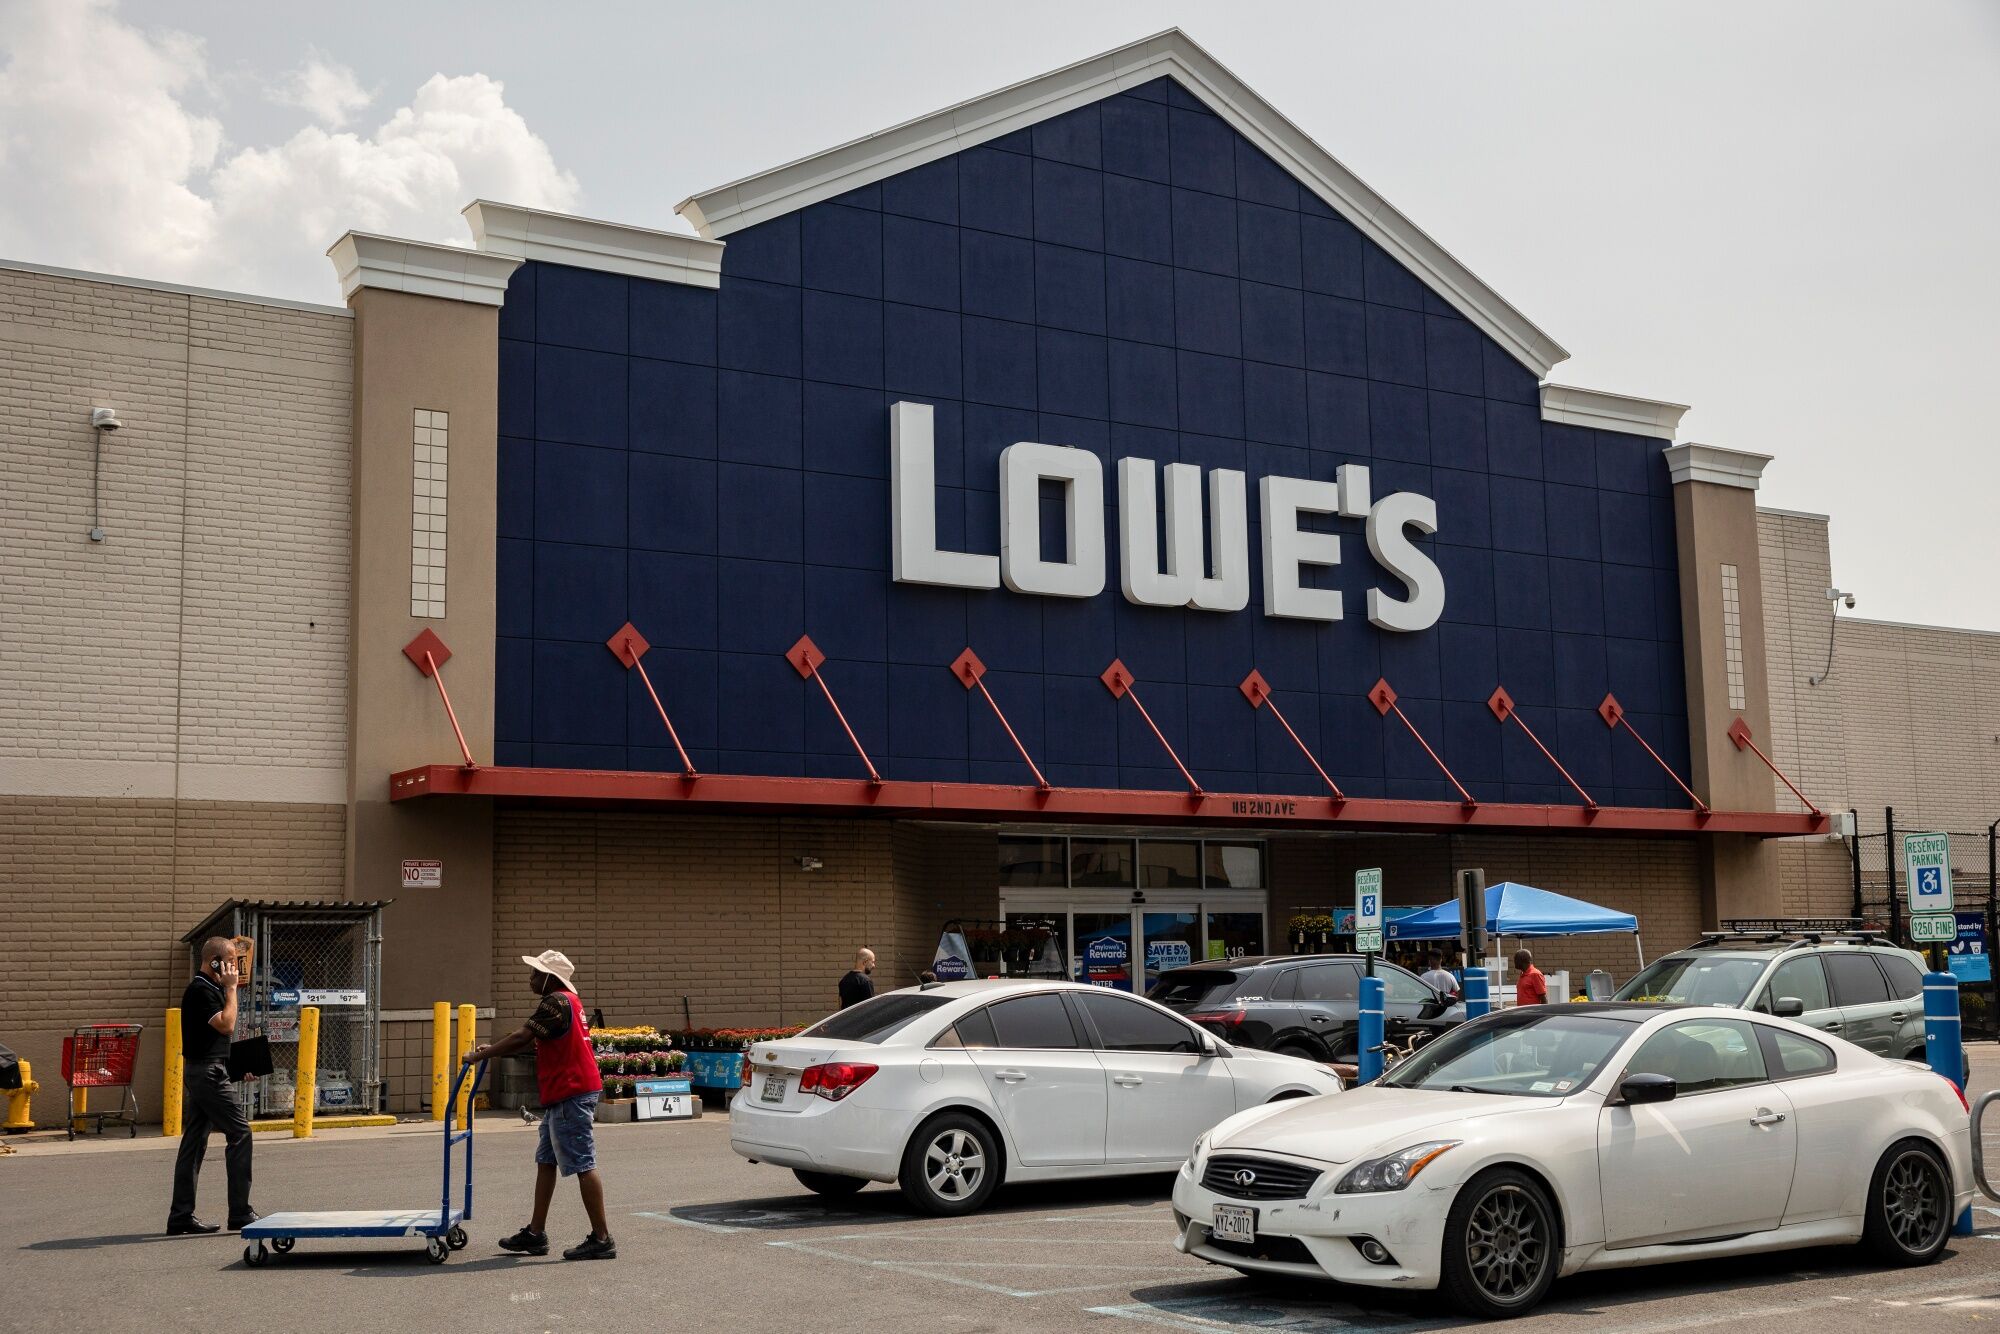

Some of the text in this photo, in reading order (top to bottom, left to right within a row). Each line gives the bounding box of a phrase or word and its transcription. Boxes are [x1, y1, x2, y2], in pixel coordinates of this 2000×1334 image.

[891, 401, 1445, 632] LOWE'S
[1232, 801, 1295, 815] 118 2ND AVE
[1907, 839, 1945, 854] RESERVED
[1912, 853, 1943, 866] PARKING
[404, 868, 420, 881] NO
[1357, 874, 1380, 885] RESERVED
[1360, 884, 1378, 894] PARKING
[1913, 921, 1953, 936] $250 FINE
[1370, 935, 1380, 946] FINE
[1089, 949, 1127, 959] Rewards
[1147, 944, 1188, 956] SAVE 5%
[1225, 946, 1245, 958] 118
[936, 965, 969, 973] Rewards
[1091, 980, 1114, 988] ENTER
[1233, 1216, 1250, 1235] 2012
